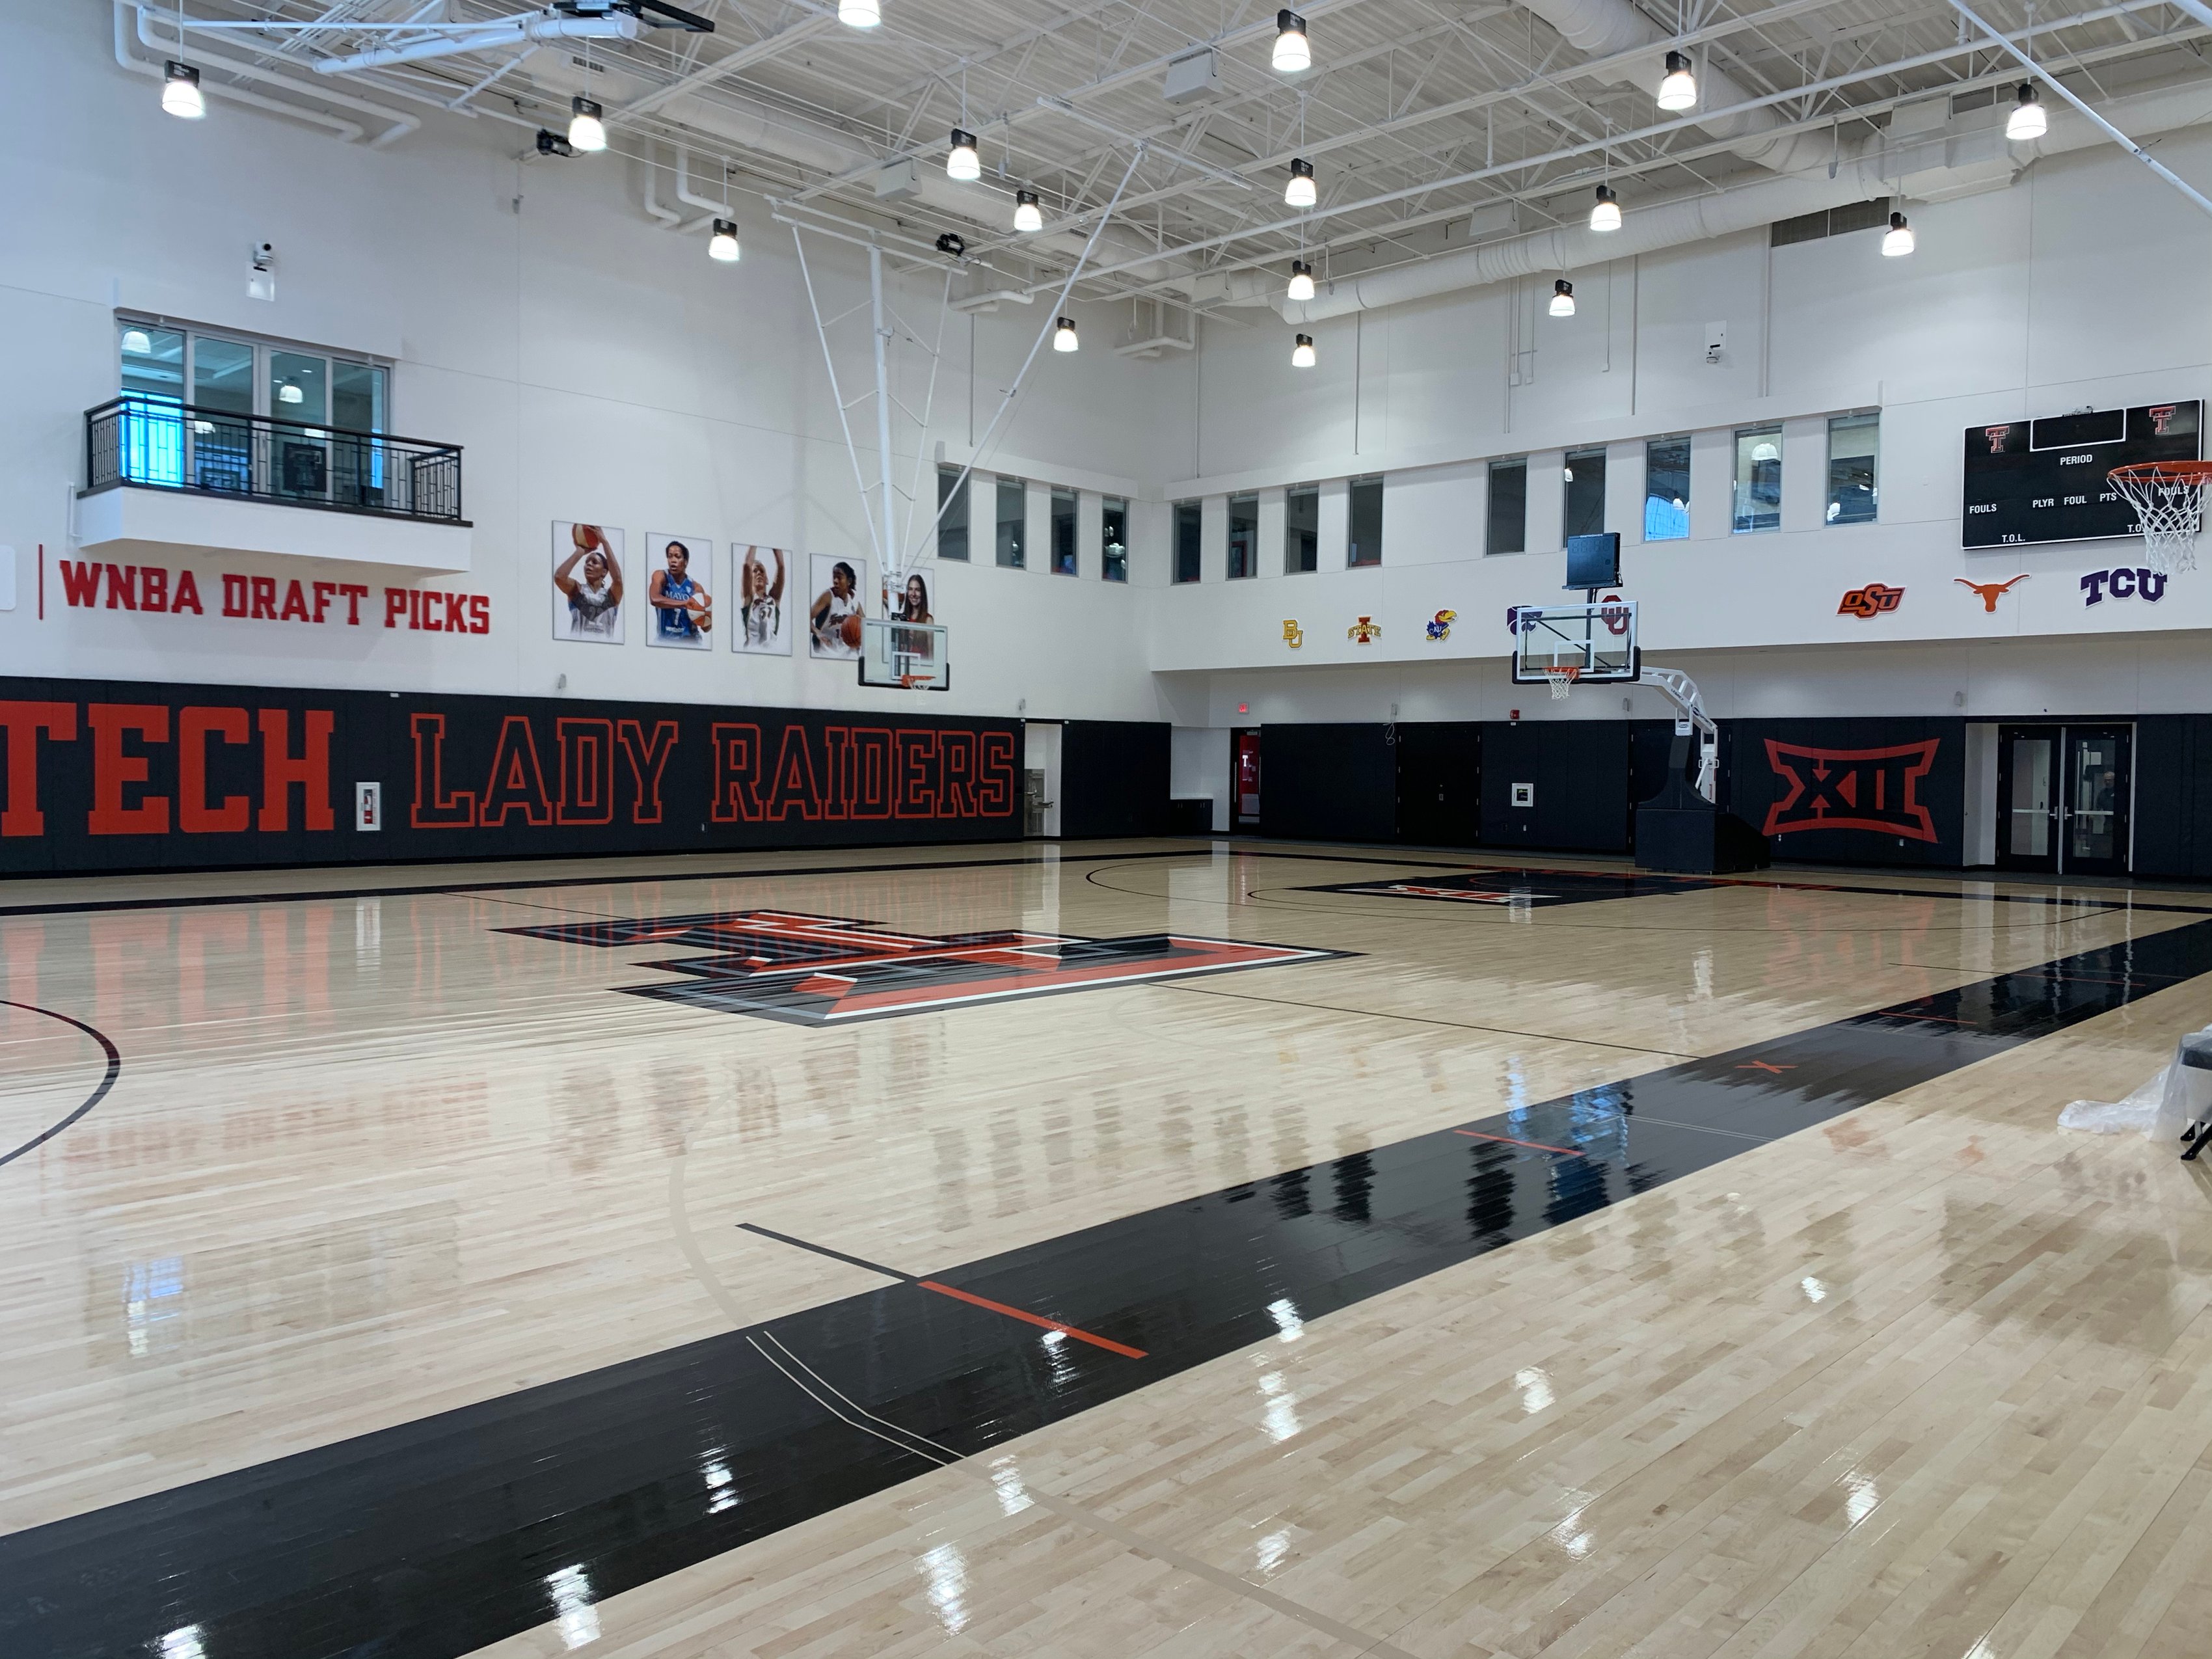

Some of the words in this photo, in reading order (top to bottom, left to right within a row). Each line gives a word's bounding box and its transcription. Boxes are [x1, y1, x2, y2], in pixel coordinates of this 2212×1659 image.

[2060, 454, 2093, 466] PERIOD
[2032, 498, 2055, 508] PLYR
[2064, 495, 2087, 506] FOUL
[2099, 492, 2117, 502] PTS
[1969, 504, 1997, 514] FOULS
[2002, 533, 2026, 543] T.O.L.
[666, 590, 690, 601] MAYO
[2081, 568, 2168, 607] TCU
[59, 560, 203, 615] WNBA
[222, 573, 368, 626] DRAFT
[384, 587, 491, 635] PICKS
[1838, 583, 1905, 619] OSU
[674, 608, 681, 626] 7
[1283, 619, 1303, 648] BU
[1348, 624, 1381, 639] STATE
[0, 701, 335, 837] TECH
[411, 712, 679, 828] LADY
[711, 722, 1015, 824] RAIDERS
